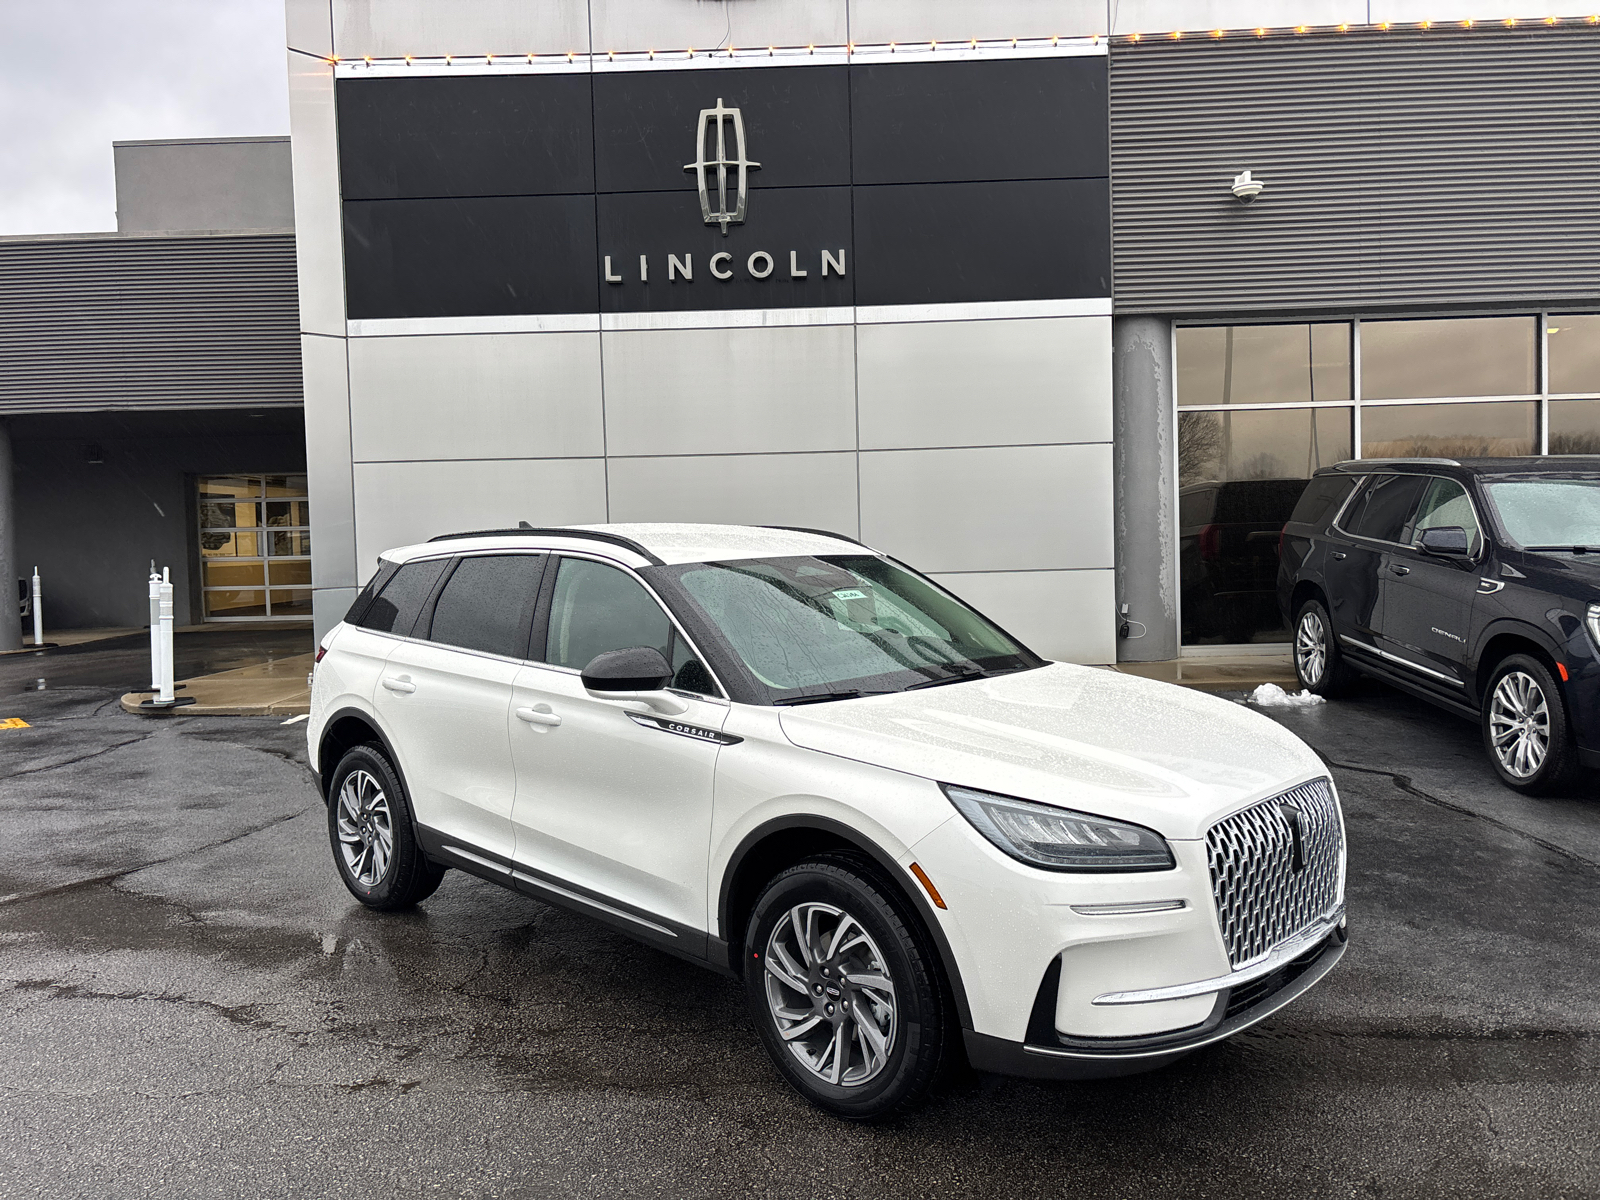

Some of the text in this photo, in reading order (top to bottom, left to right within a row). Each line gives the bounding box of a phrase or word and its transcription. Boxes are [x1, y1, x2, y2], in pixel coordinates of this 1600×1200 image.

[604, 249, 846, 283] LINCOLN
[1431, 626, 1467, 644] DENALI
[668, 723, 716, 739] CORSAIR
